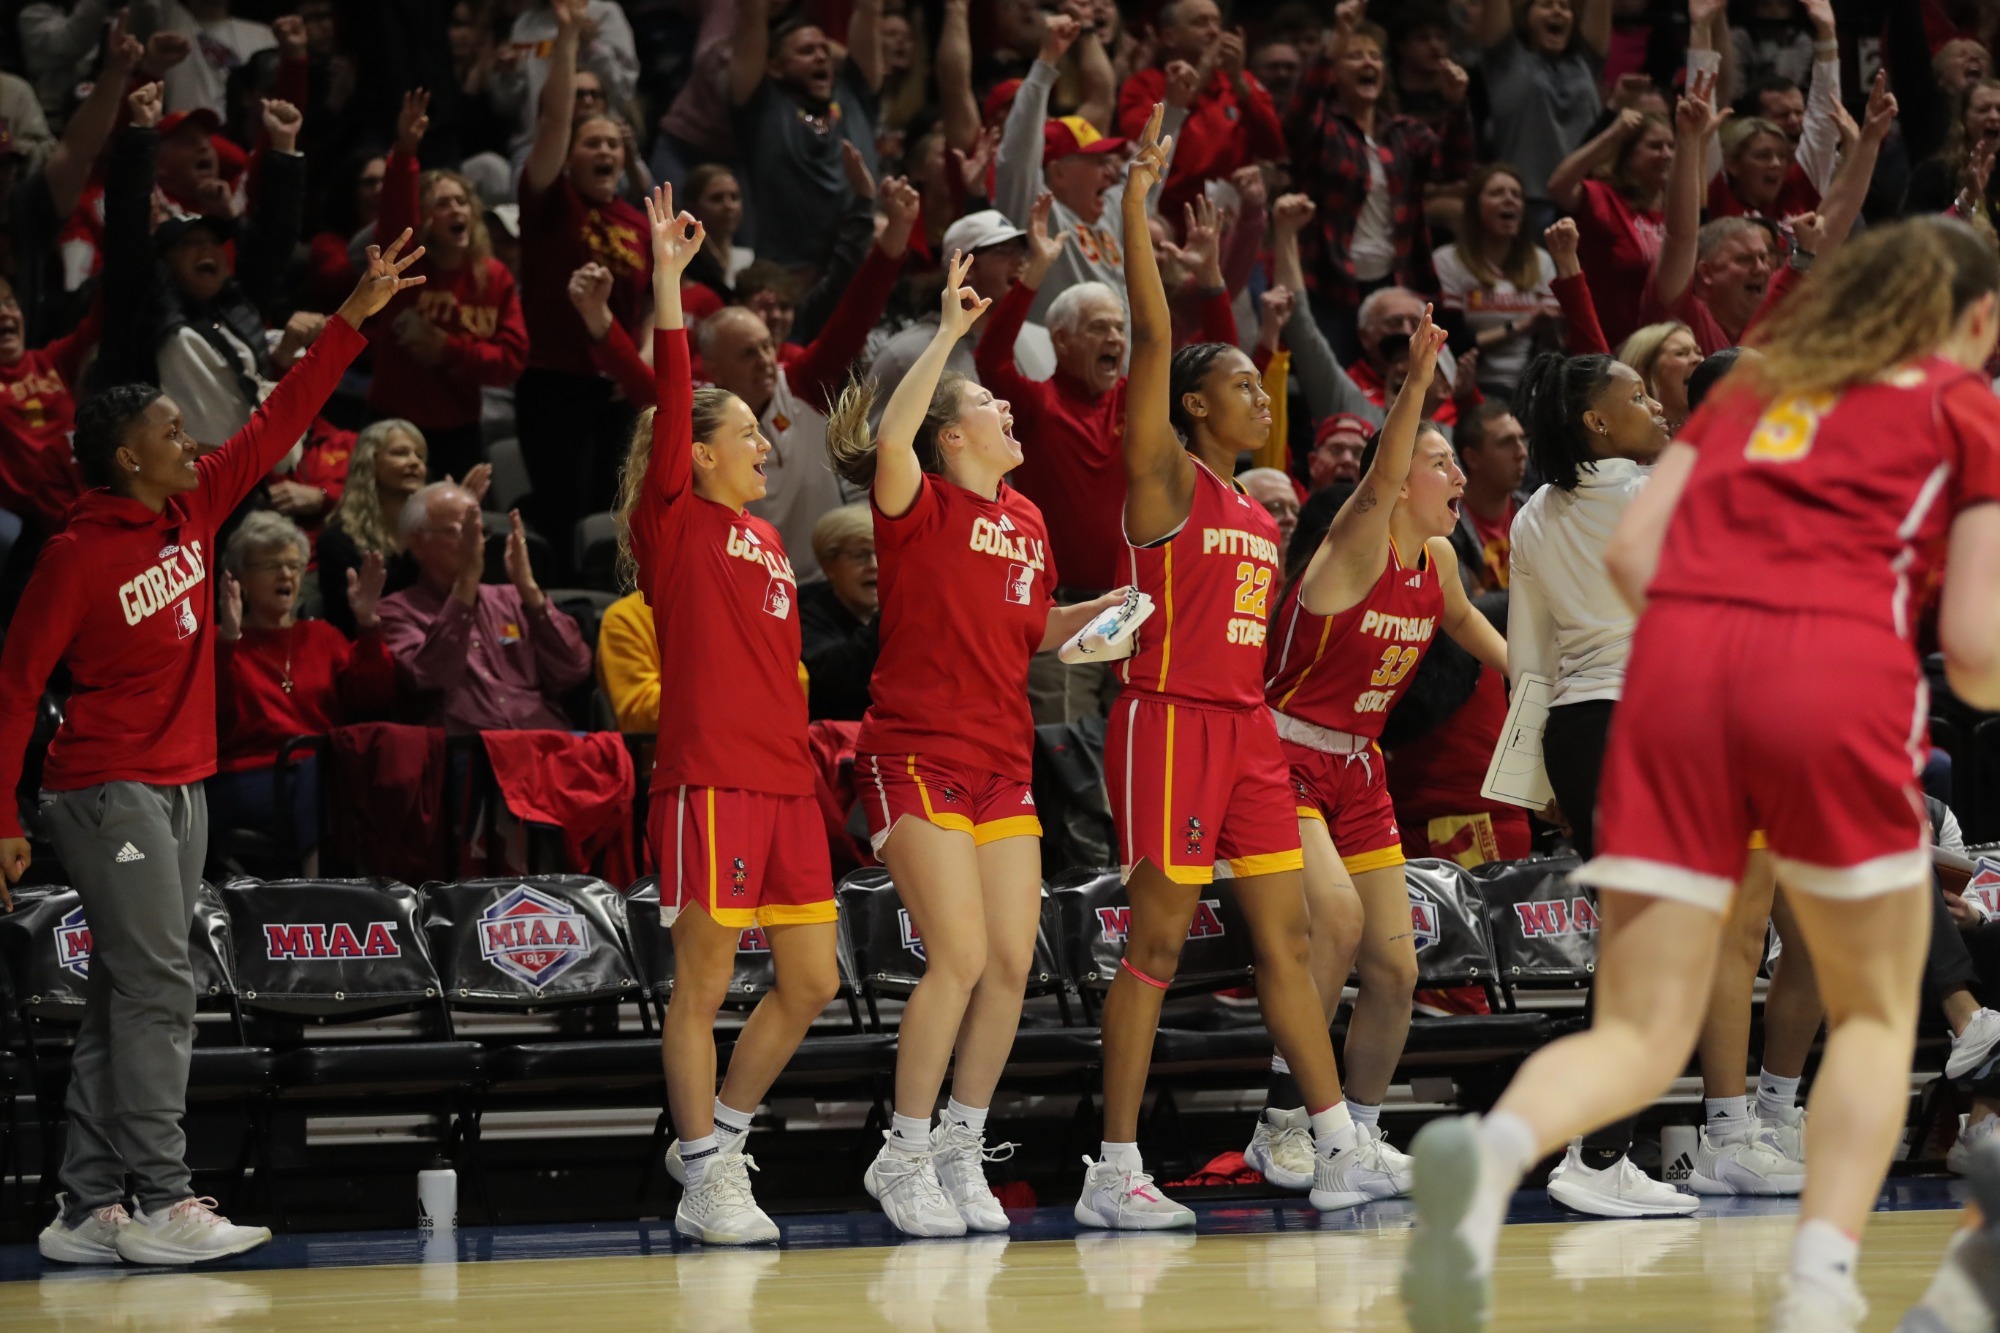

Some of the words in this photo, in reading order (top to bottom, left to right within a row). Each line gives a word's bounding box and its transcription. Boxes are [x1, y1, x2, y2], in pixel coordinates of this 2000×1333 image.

[1234, 561, 1272, 620] 22
[1370, 645, 1419, 686] 33
[116, 852, 145, 863] adidas
[1514, 897, 1599, 937] MIA
[265, 923, 400, 959] MIAA
[486, 919, 581, 951] MIAA
[521, 953, 547, 965] 1912
[1666, 1170, 1692, 1180] adid
